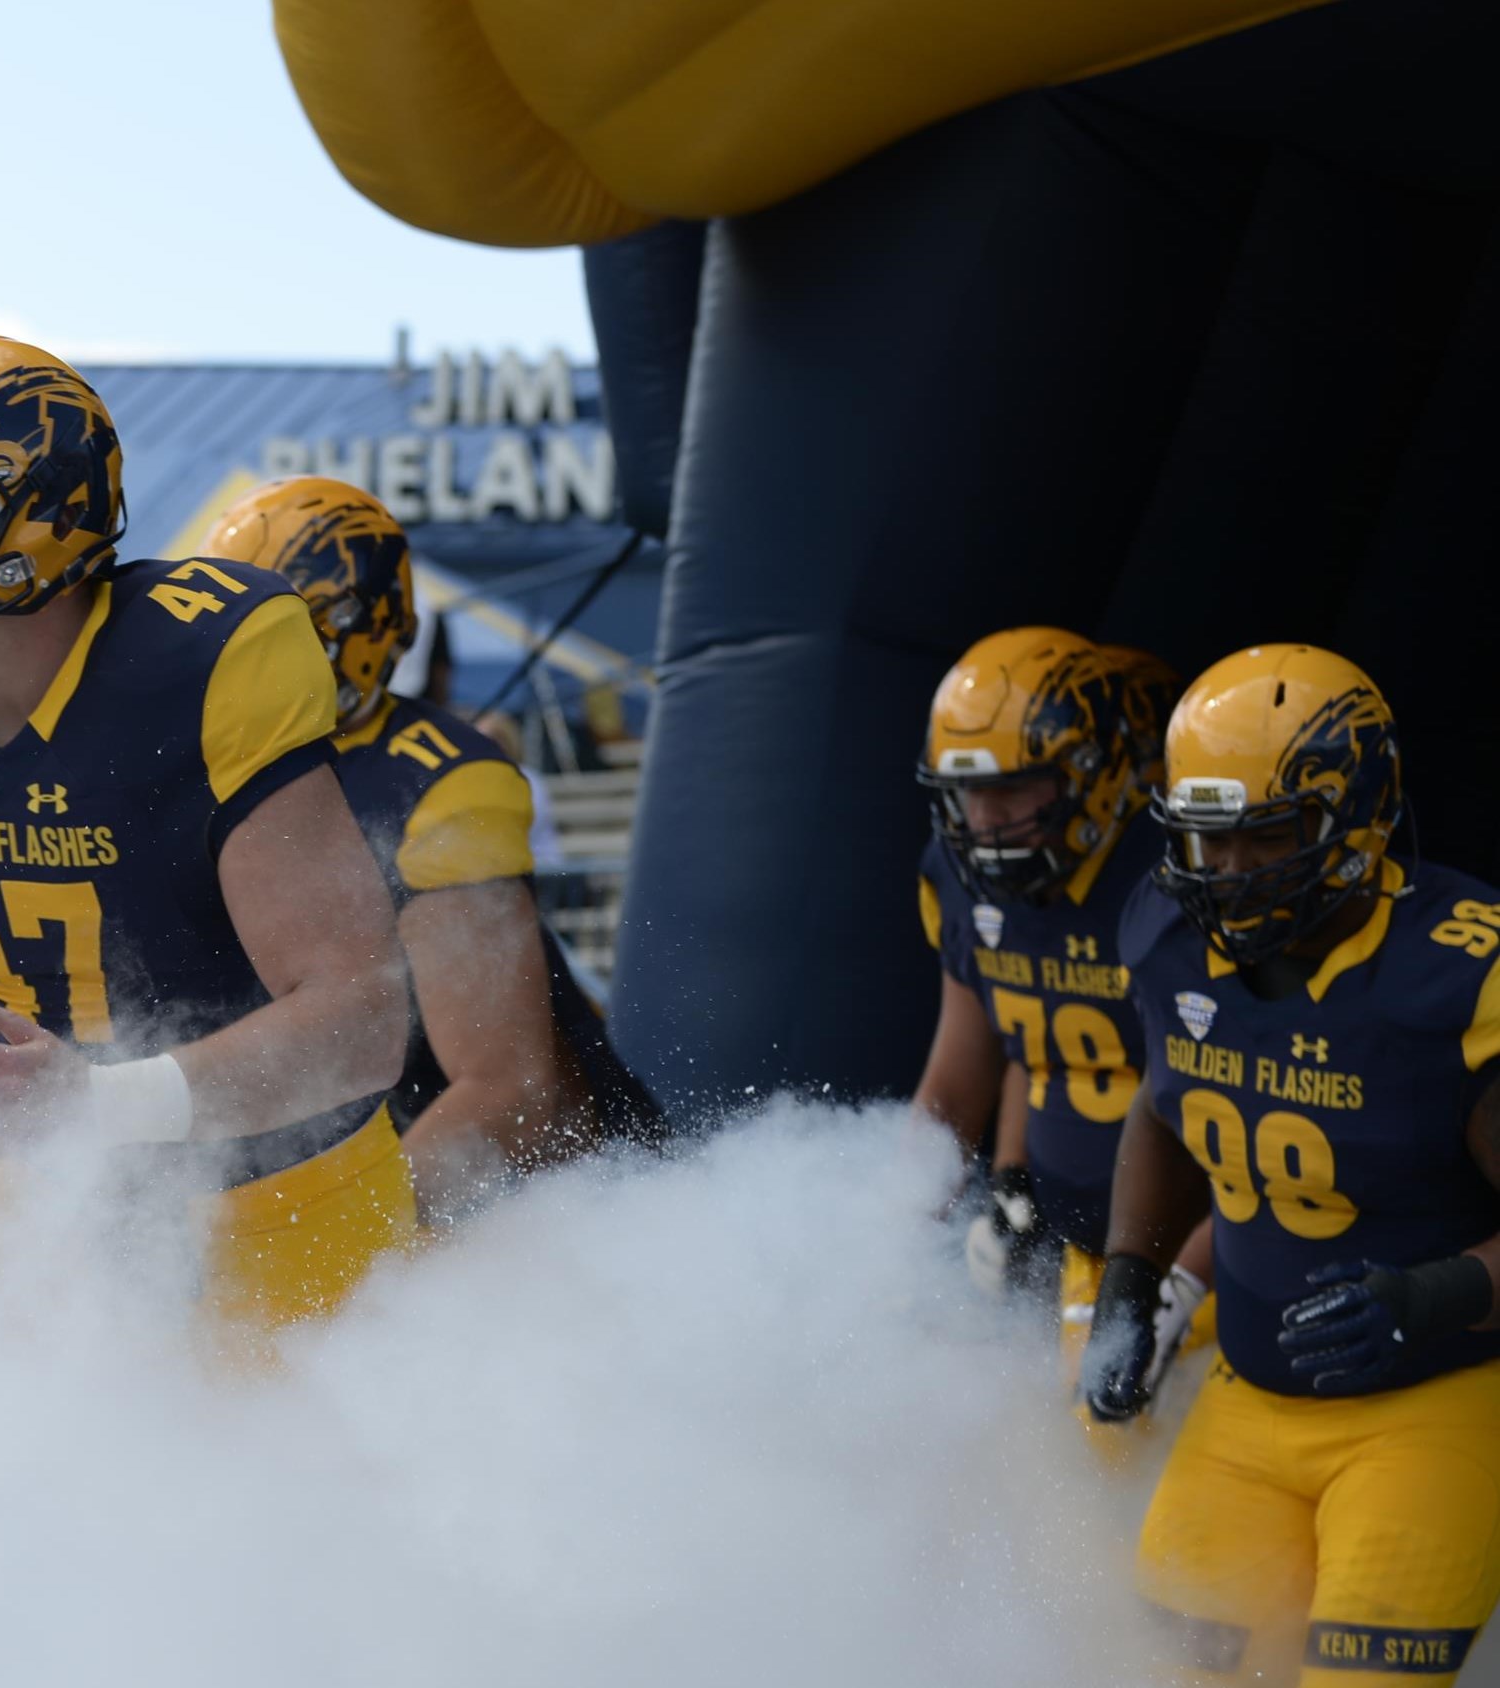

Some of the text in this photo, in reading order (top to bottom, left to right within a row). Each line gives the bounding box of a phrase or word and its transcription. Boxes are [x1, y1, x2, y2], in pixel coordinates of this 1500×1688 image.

[412, 349, 577, 426] JIM
[263, 431, 613, 522] PHELAN
[147, 560, 248, 624] 47
[388, 719, 460, 770] 17
[1429, 899, 1500, 958] 98
[1041, 957, 1130, 999] FLASHES
[992, 987, 1140, 1123] 78
[1166, 1034, 1364, 1109] GOLDEN FLASHES
[1181, 1088, 1358, 1240] 98
[1319, 1633, 1449, 1664] KENT STATE
